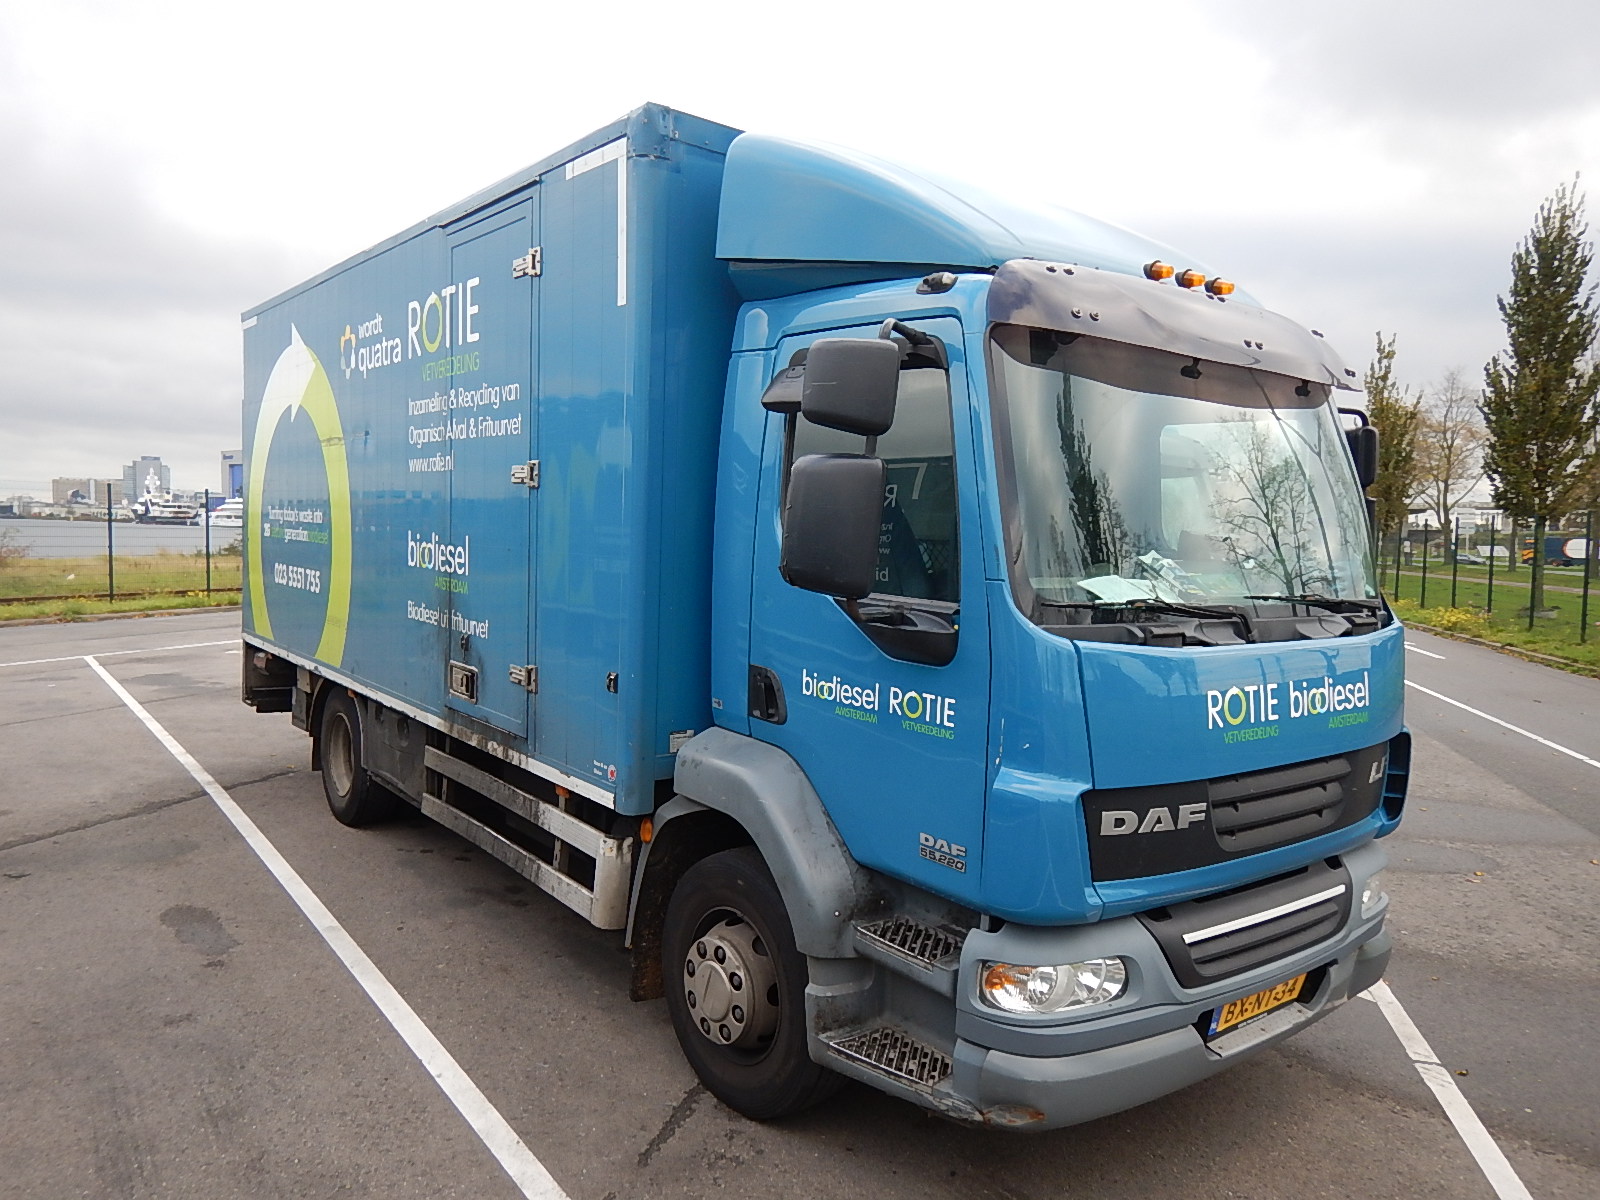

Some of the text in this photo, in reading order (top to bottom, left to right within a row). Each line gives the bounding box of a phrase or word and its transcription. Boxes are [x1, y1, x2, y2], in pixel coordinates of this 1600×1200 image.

[358, 313, 382, 339] wordt
[408, 276, 480, 359] ROTIE
[358, 337, 401, 379] quatra
[421, 352, 480, 381] VETVEREDELING
[408, 382, 520, 416] Inzameling & Recycling van
[408, 413, 522, 448] Organisch Afval & Frituurvet
[408, 450, 454, 473] www.rotie.nl
[407, 529, 469, 576] biodiesel
[274, 562, 321, 594] 023 5551 755
[434, 576, 469, 595] AMSTERDAM
[407, 599, 489, 639] Biodiesel uit frituurvet
[802, 668, 956, 728] biodiesel ROTIE
[1207, 671, 1370, 729] ROTIE biodiesel
[834, 705, 878, 725] AMSTERDAM
[901, 719, 955, 740] VETVEREDELING
[1328, 712, 1369, 729] AMSTERDAM
[1223, 725, 1279, 744] VETVEREDELING
[1100, 802, 1207, 836] DAF
[919, 832, 966, 857] DAF
[920, 846, 965, 871] 55.220
[1223, 977, 1299, 1024] BX-NT-34
